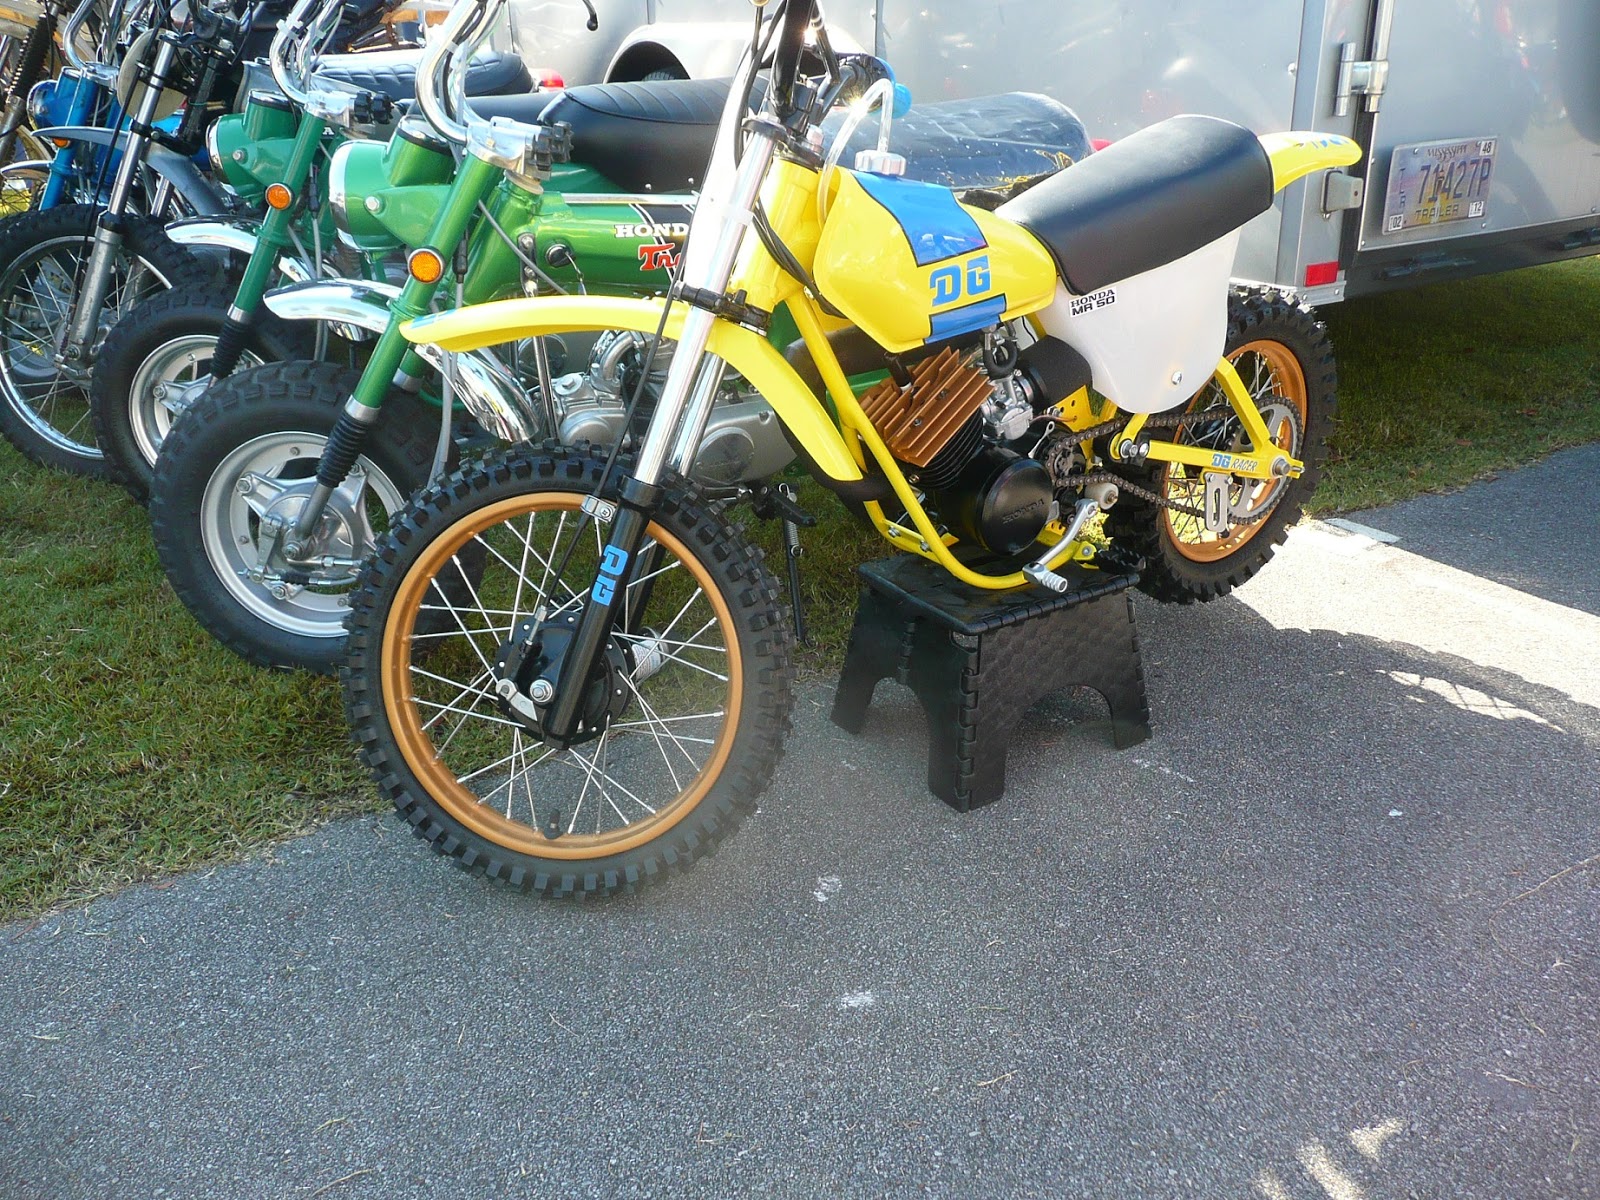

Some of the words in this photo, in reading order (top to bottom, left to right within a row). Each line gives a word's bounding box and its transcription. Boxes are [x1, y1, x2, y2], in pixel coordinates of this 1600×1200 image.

[1482, 141, 1492, 154] 48
[1415, 204, 1460, 220] TRAILER
[614, 223, 690, 238] HOND
[929, 254, 991, 308] DG
[1071, 289, 1115, 308] HONDA
[1072, 303, 1093, 316] MR
[1097, 295, 1115, 308] 50
[1211, 453, 1232, 468] DG
[1231, 458, 1258, 472] RACER
[591, 544, 629, 606] DG
